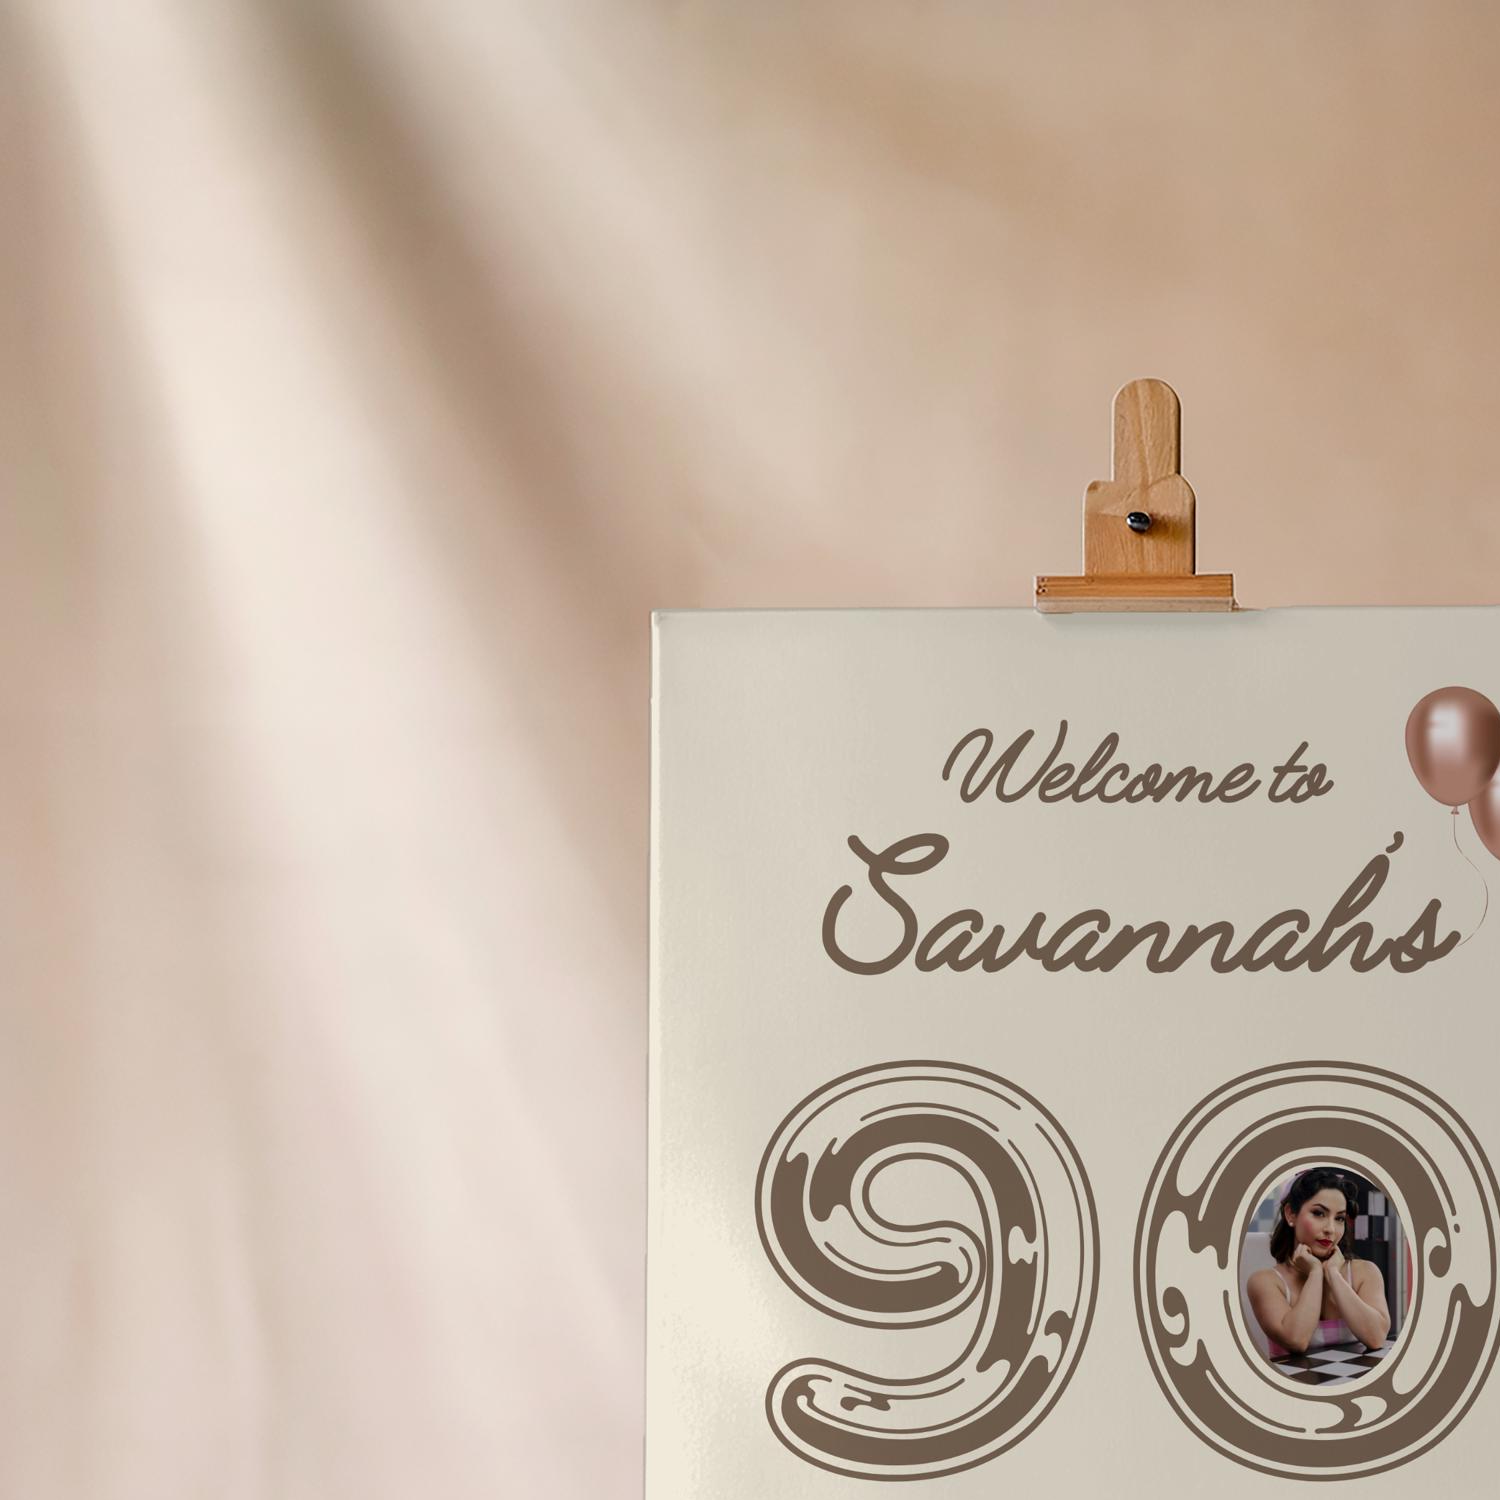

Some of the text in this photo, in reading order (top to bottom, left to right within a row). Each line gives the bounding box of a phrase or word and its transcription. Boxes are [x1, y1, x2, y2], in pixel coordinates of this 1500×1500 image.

[942, 719, 1334, 804] Welcome to
[822, 831, 1461, 976] Savannah's
